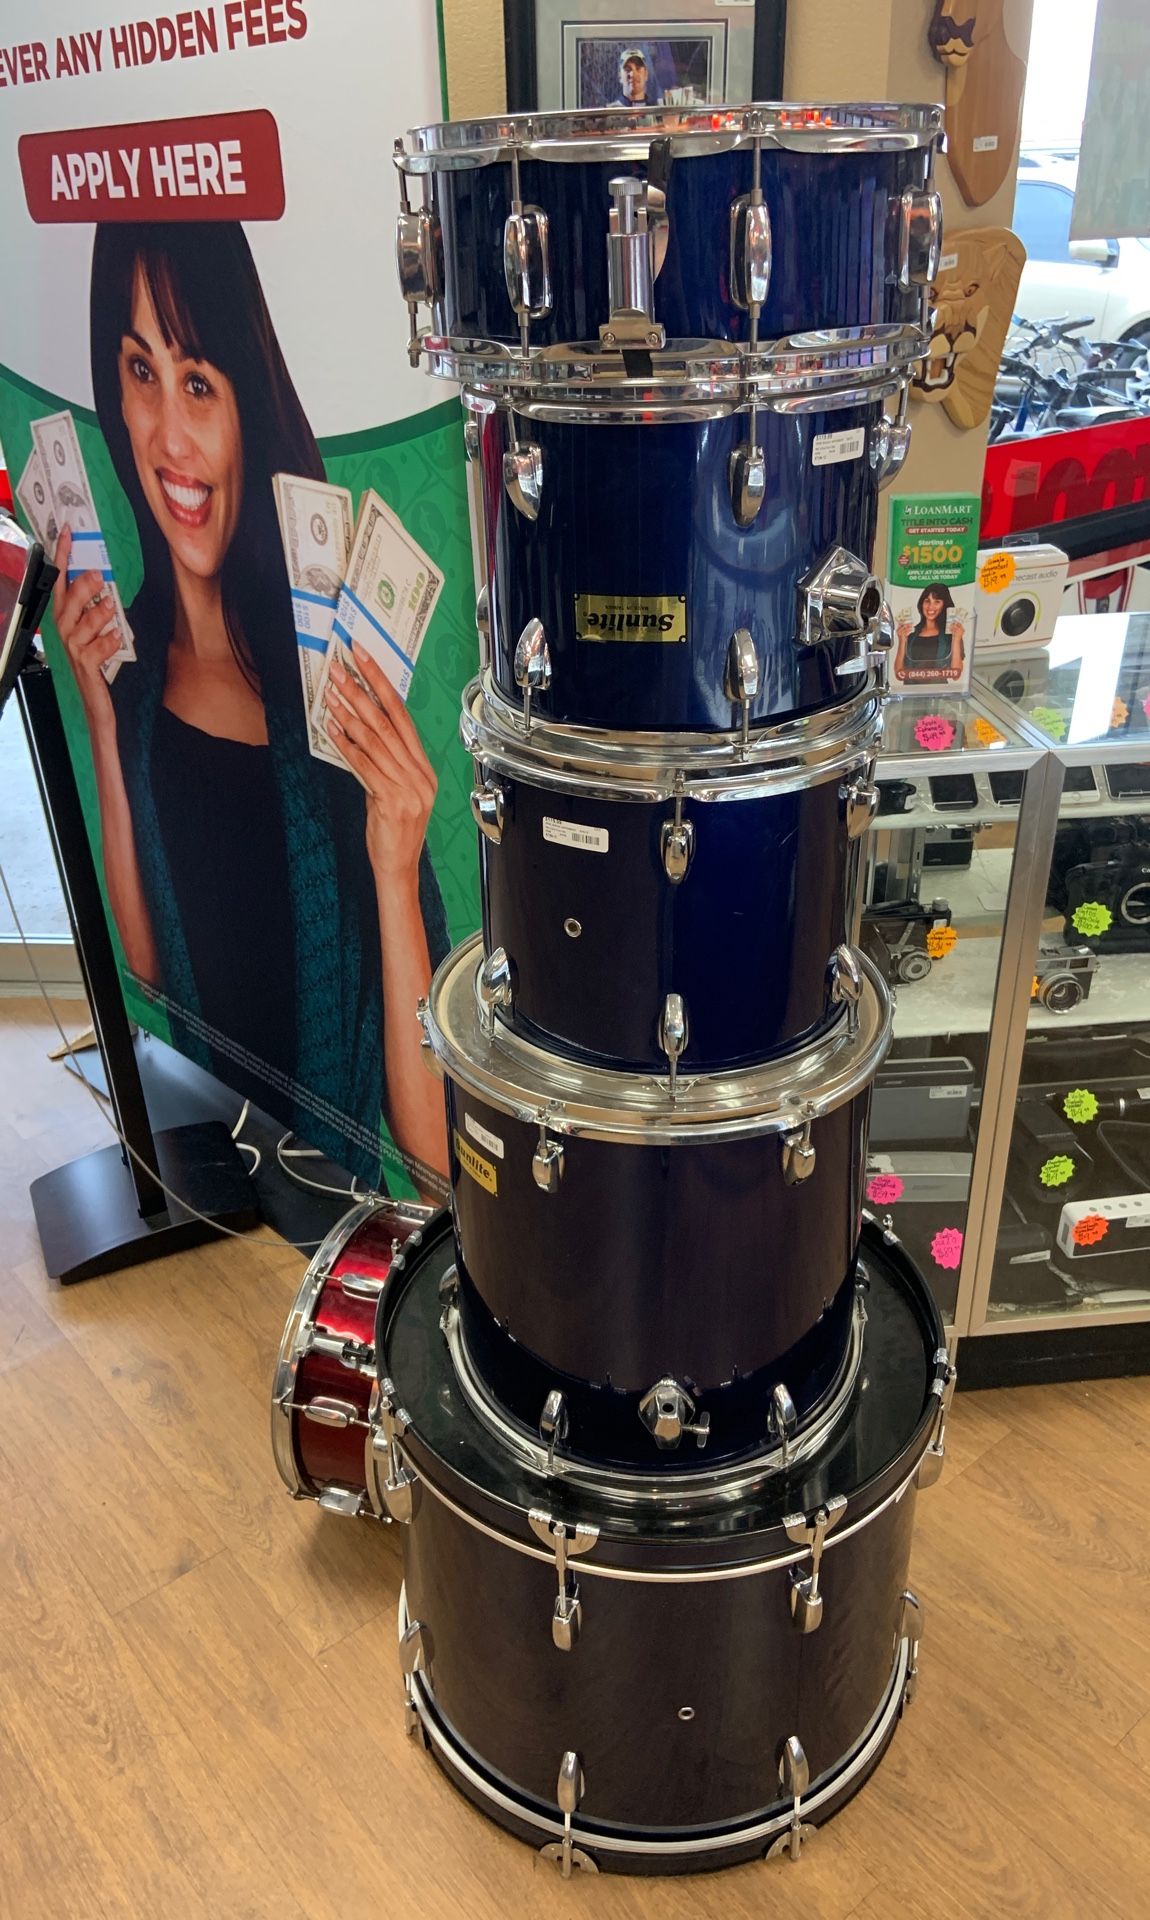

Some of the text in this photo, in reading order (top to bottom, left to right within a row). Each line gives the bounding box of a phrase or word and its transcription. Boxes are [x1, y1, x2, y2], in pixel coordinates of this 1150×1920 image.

[56, 30, 102, 78] ANY
[110, 7, 218, 69] HIDDEN
[224, 0, 307, 50] FEES
[51, 140, 247, 201] APPLY HERE
[901, 517, 973, 527] TITLE INTO CASH
[903, 545, 963, 564] $1500
